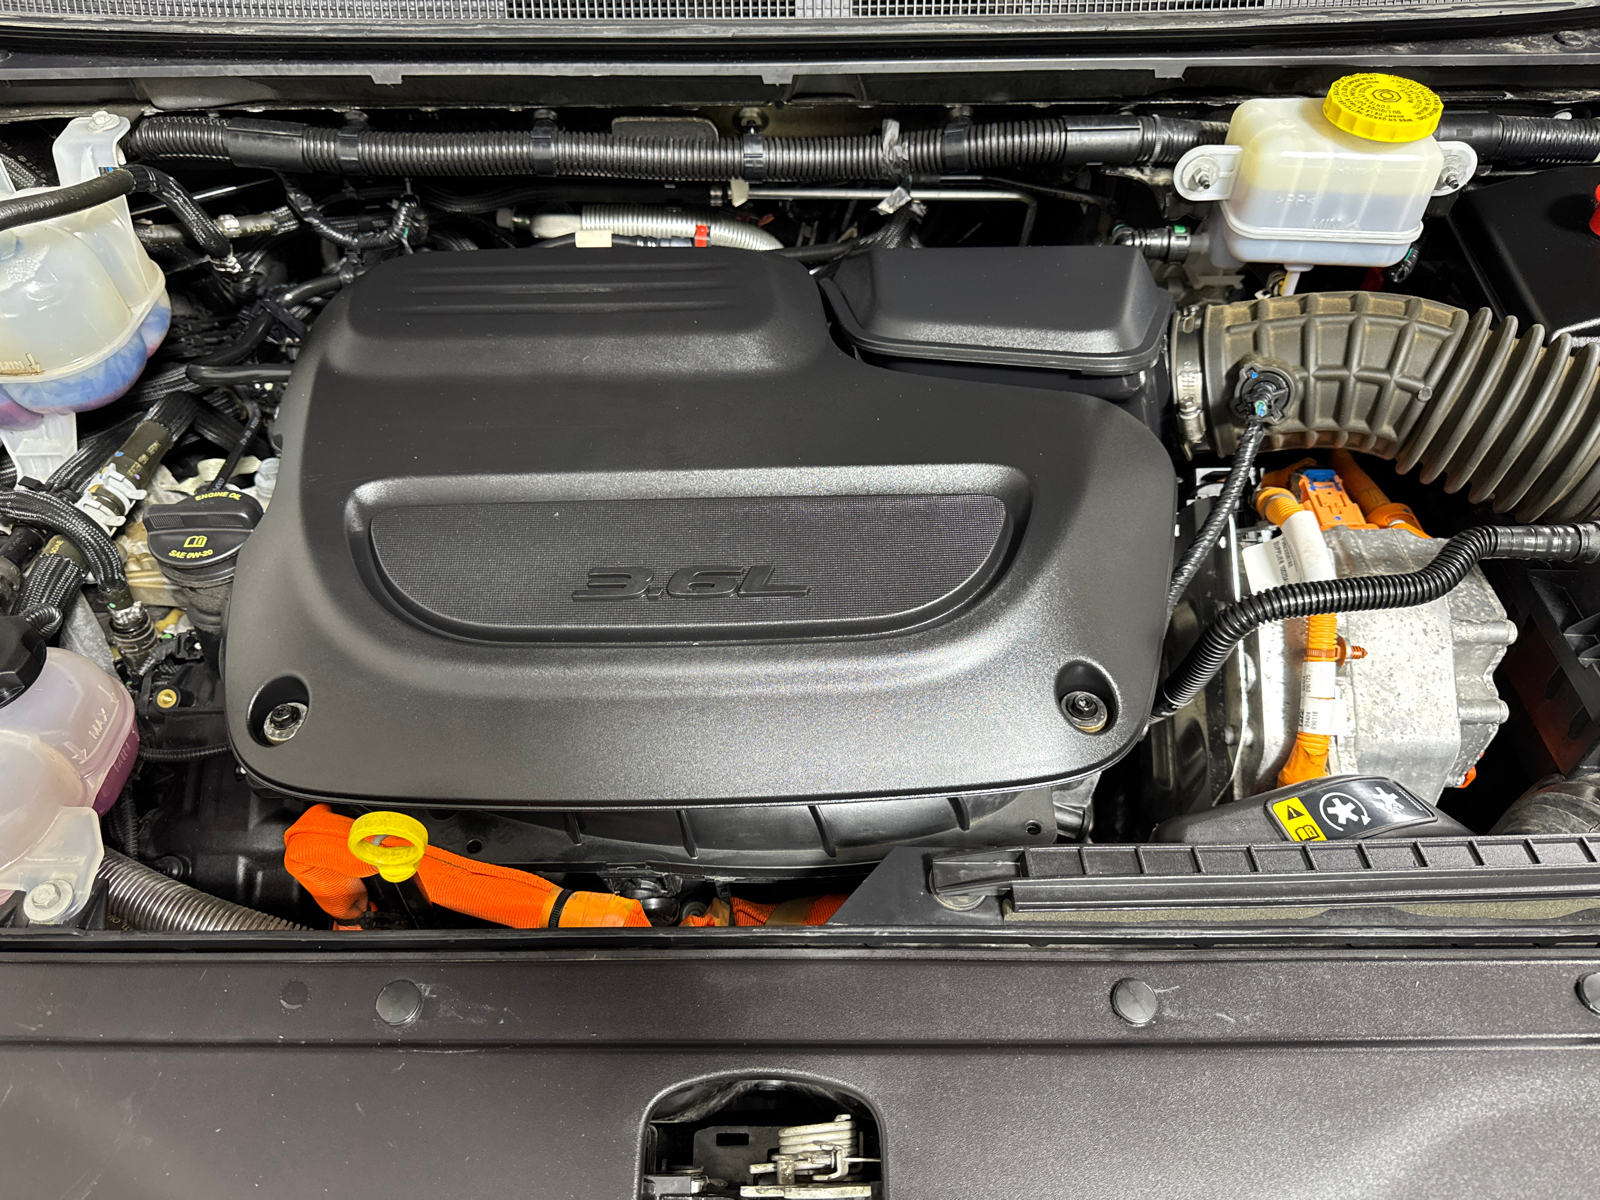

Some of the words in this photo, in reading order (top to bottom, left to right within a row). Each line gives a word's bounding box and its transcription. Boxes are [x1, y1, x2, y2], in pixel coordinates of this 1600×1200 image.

[195, 491, 229, 501] ENGINE
[228, 493, 242, 501] OIL
[168, 549, 186, 559] SAE
[186, 549, 213, 559] 0W-20
[572, 564, 811, 602] 3.6L
[88, 707, 109, 739] MAX
[114, 742, 131, 773] MIN
